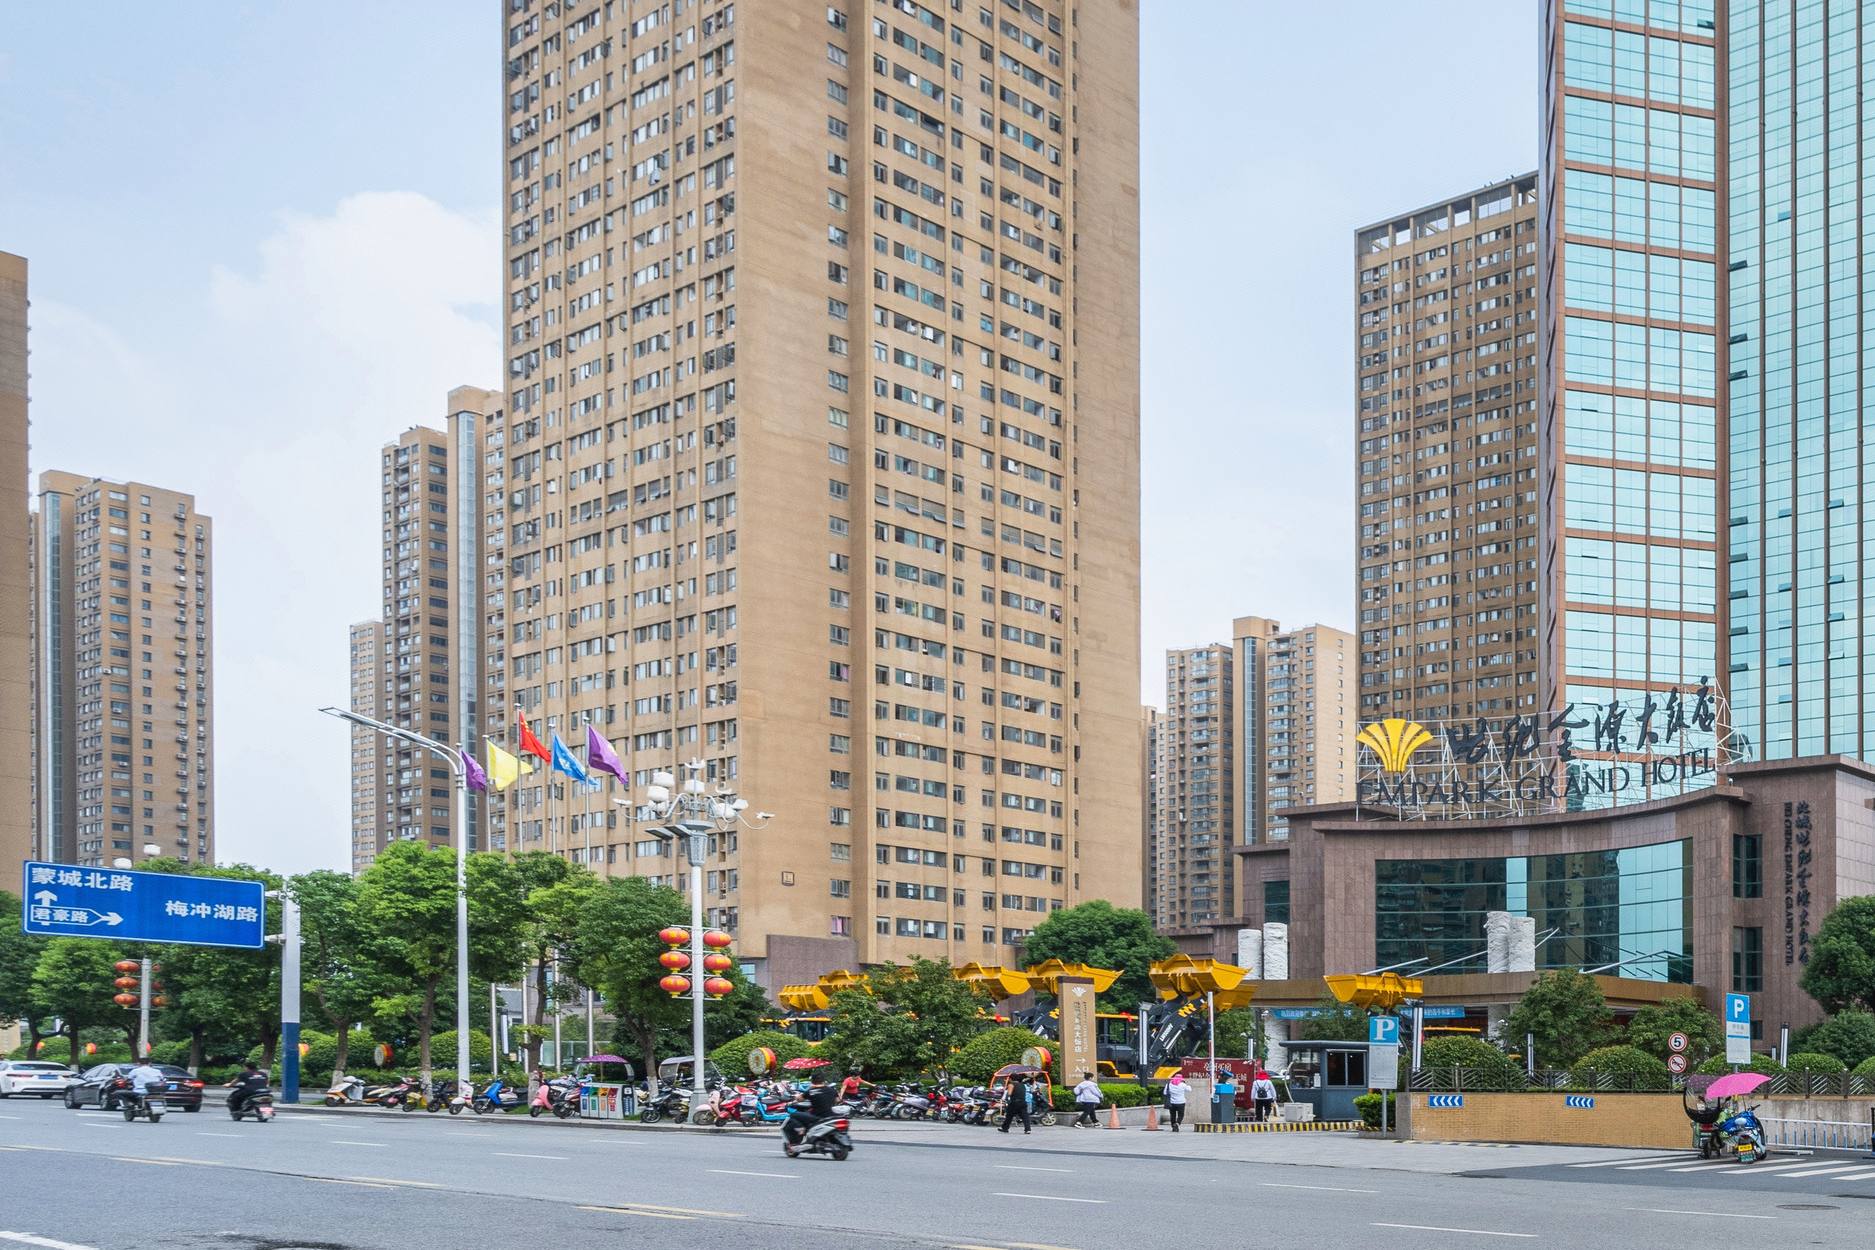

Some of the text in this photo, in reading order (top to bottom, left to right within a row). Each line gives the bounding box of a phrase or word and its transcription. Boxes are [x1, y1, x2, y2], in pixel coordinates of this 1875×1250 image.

[1355, 747, 1716, 806] EMPARK GRAND HOTEL
[1784, 819, 1793, 852] CHENG
[31, 867, 134, 892] 蒙城北路
[1784, 853, 1793, 894] EMPARK
[33, 907, 89, 923] 君豪路
[165, 900, 259, 923] 梅冲湖路
[1784, 896, 1793, 933] GRAND
[1785, 935, 1794, 966] HOTEL
[1734, 999, 1745, 1019] P
[1373, 1018, 1396, 1041] P
[1673, 1036, 1682, 1048] 5
